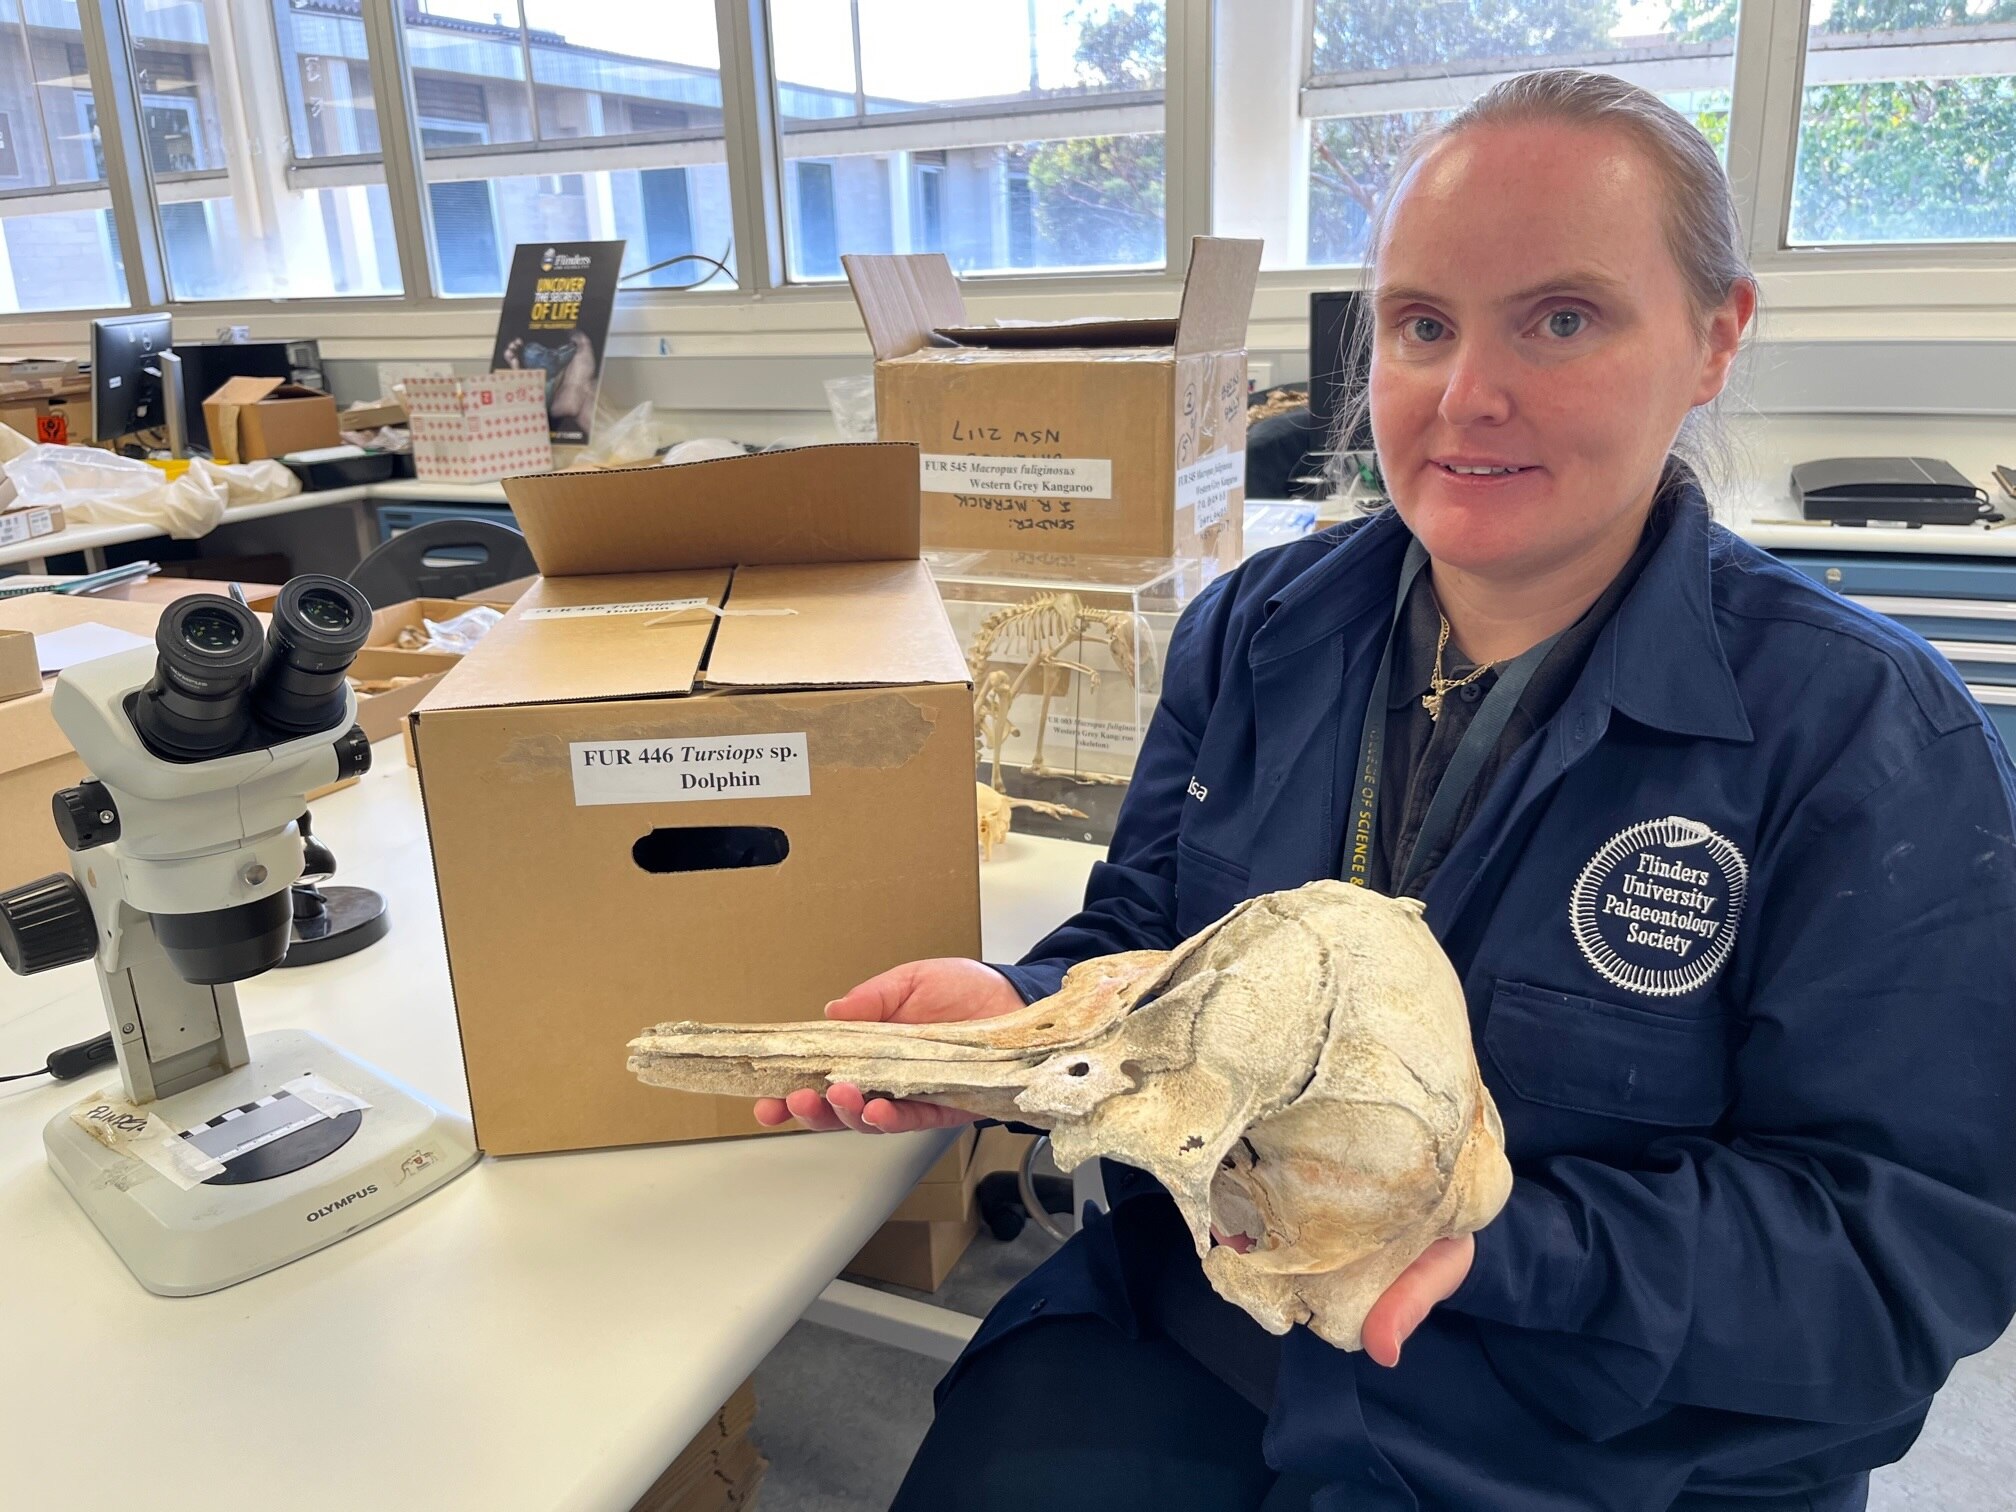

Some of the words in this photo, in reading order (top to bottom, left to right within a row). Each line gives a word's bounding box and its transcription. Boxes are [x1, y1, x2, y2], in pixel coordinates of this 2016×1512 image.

[537, 277, 586, 292] UNCOVER
[531, 303, 550, 320] OF
[551, 302, 580, 320] LIFE
[952, 421, 1001, 441] 2117
[1014, 429, 1059, 444] NSW
[925, 461, 948, 472] FUR
[950, 462, 967, 472] 545
[969, 463, 1018, 476] Macropus
[1020, 464, 1075, 477] fuliginosus
[970, 478, 1011, 491] Western
[1014, 480, 1039, 493] Grey
[1042, 480, 1093, 493] Kangaroo
[954, 494, 1027, 512] MERRICK
[1009, 518, 1075, 531] SENDER:
[1081, 729, 1098, 739] Grey
[584, 749, 632, 767] FUR
[639, 747, 674, 765] 446
[680, 745, 764, 763] Tursiops
[770, 743, 797, 763] sp.
[680, 772, 761, 792] Dolphin
[1187, 776, 1208, 802] isa
[1361, 787, 1374, 808] OF
[1351, 811, 1371, 873] SCIENCE
[1637, 853, 1710, 887] Flinders
[1622, 874, 1718, 914] University
[1602, 894, 1720, 939] Palaeontology
[1626, 921, 1693, 957] Society
[306, 1184, 379, 1222] OLYMPUS
